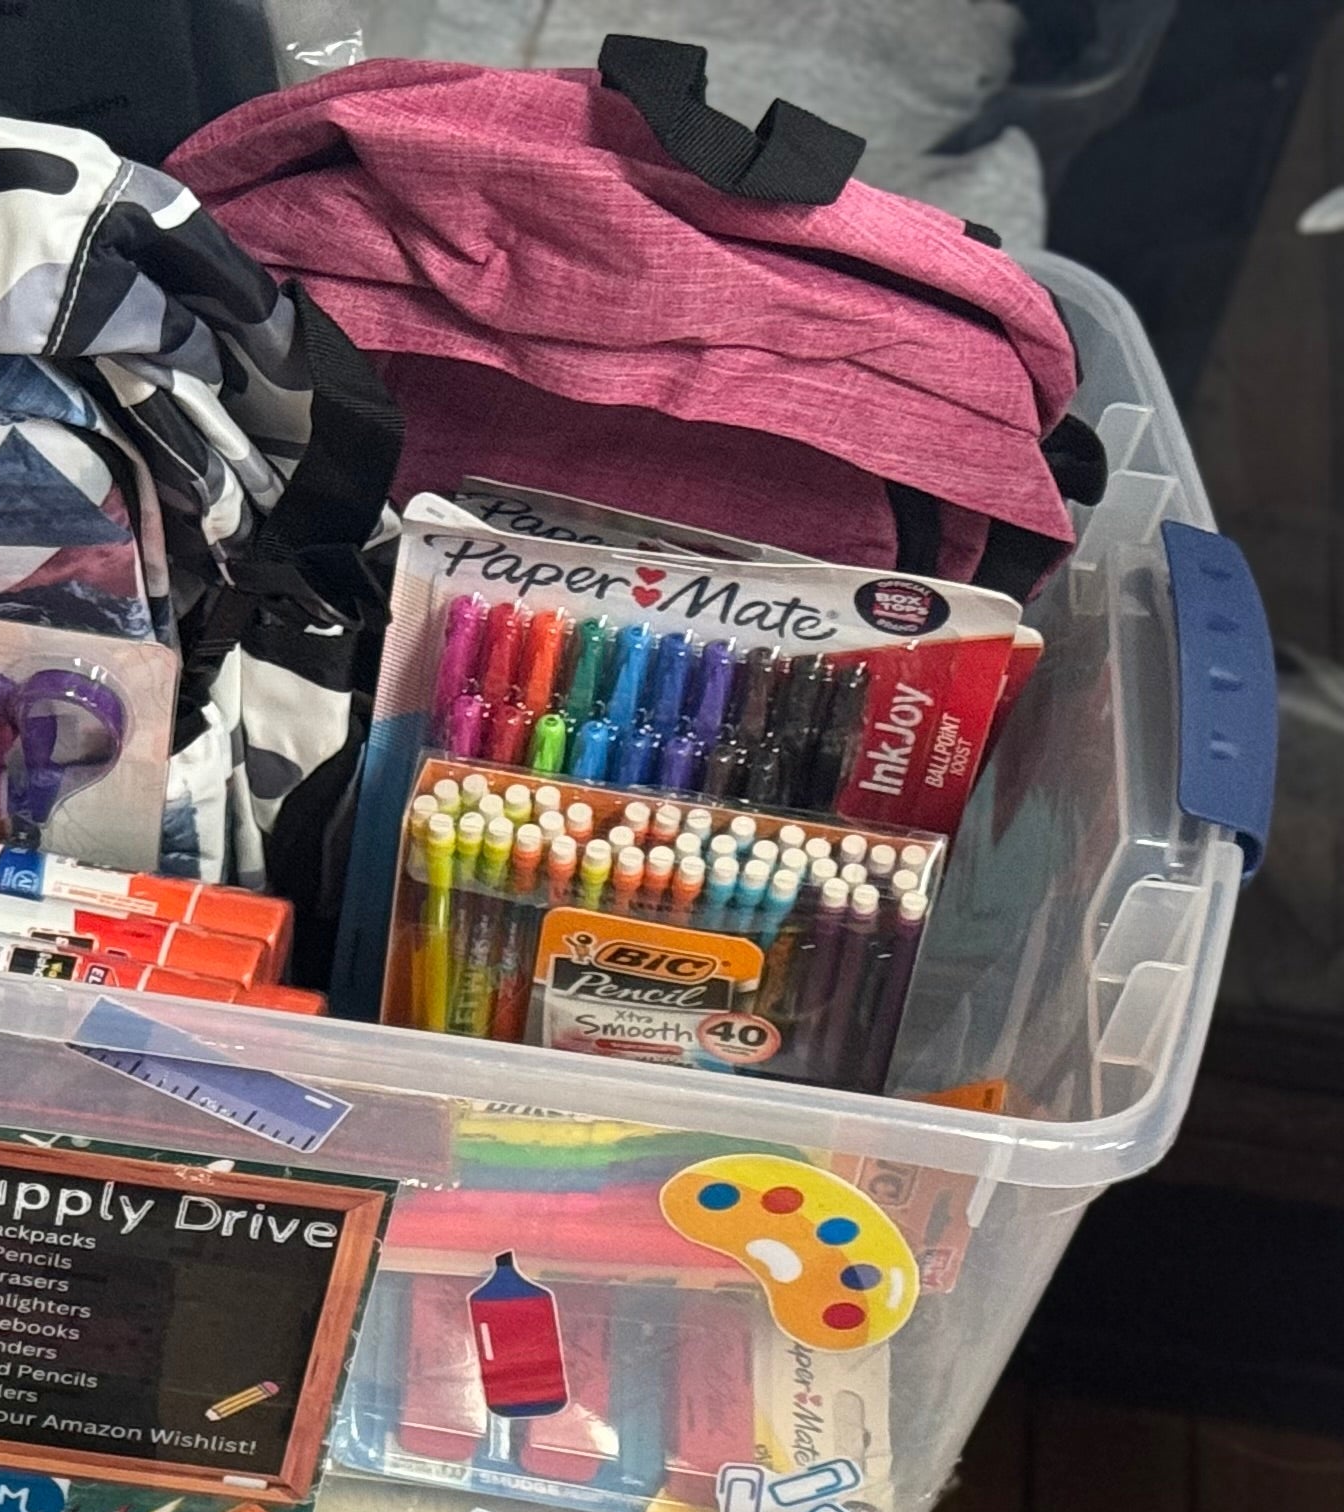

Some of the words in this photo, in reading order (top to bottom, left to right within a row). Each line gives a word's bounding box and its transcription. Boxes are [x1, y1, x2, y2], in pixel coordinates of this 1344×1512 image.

[424, 533, 630, 600] Paper
[656, 575, 839, 641] Mate
[874, 592, 924, 607] BOX
[882, 602, 929, 616] TOPS
[858, 682, 935, 796] InkJoy
[924, 712, 962, 789] BALLPOINT
[603, 946, 708, 979] BIC
[567, 971, 710, 1009] Pencil
[575, 1013, 694, 1043] Smooth
[707, 1021, 768, 1047] 40
[174, 1195, 339, 1249] Drive
[16, 1363, 99, 1389] Pencils
[41, 1413, 143, 1441] Amazon
[149, 1427, 258, 1456] Wishlist!
[791, 1401, 825, 1467] Mate
